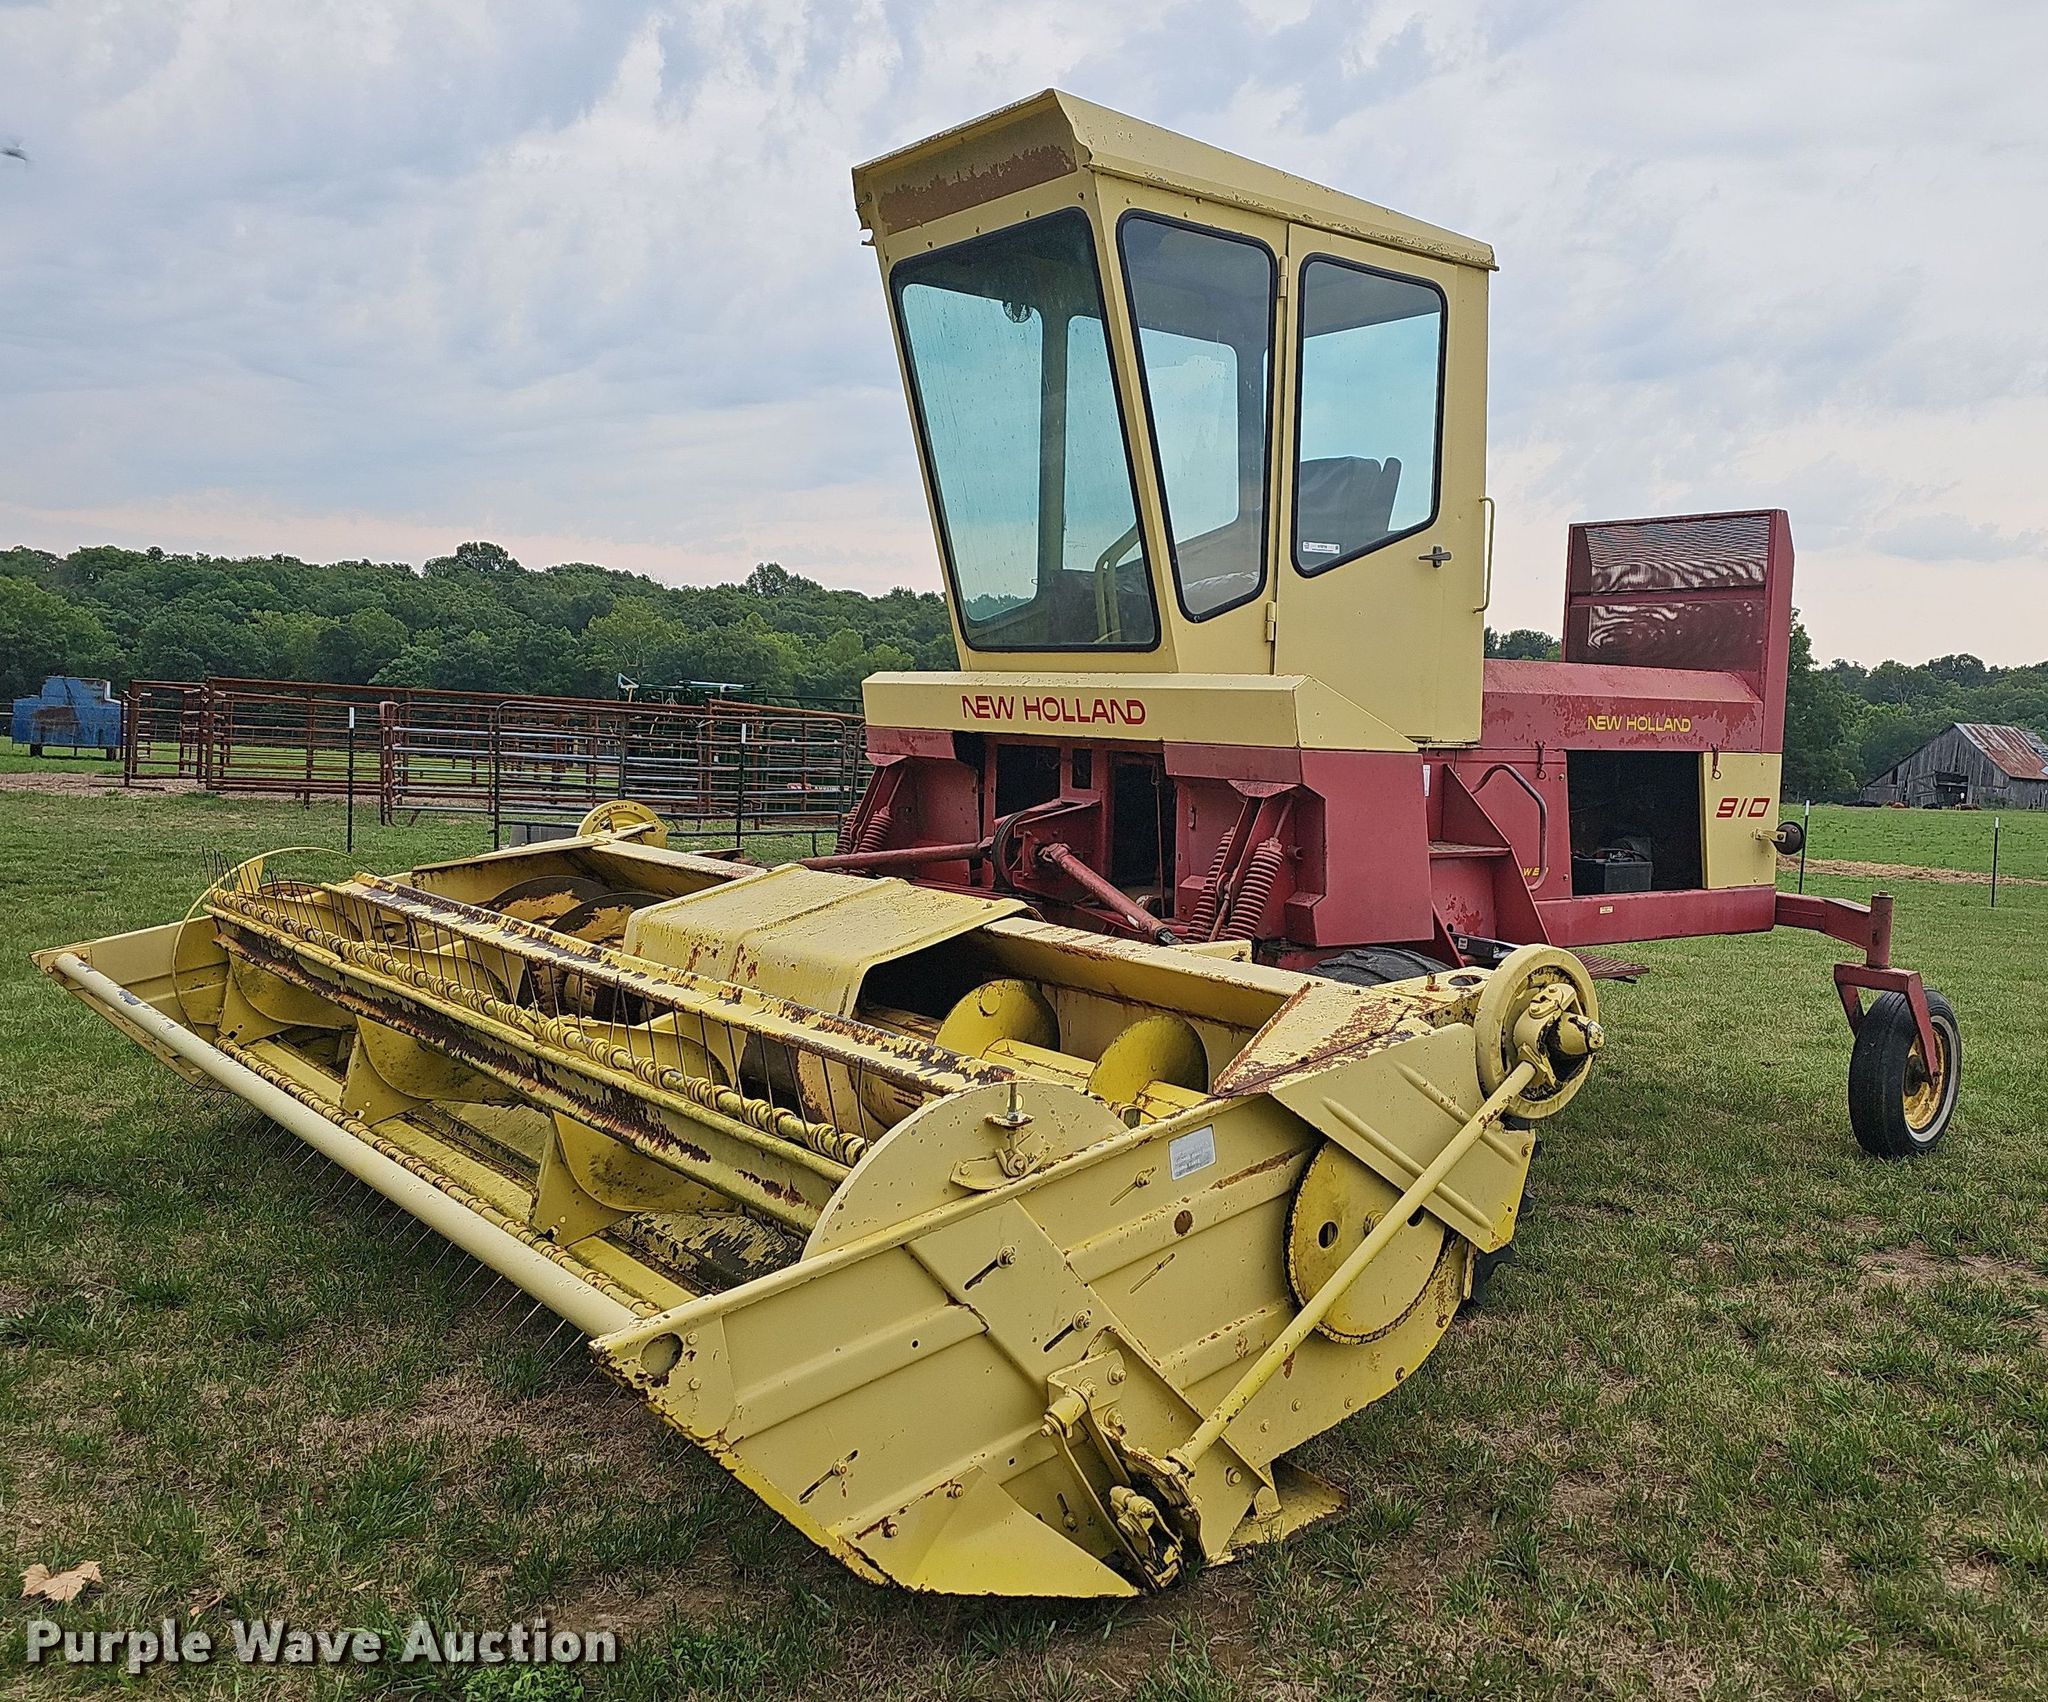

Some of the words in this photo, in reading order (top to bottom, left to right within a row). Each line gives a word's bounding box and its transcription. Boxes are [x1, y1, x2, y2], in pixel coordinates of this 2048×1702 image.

[961, 695, 1015, 720] NEW
[1022, 696, 1146, 725] HOLLAND
[1587, 715, 1622, 731] NEW
[1626, 716, 1692, 733] HOLLAND
[1715, 797, 1771, 819] 910
